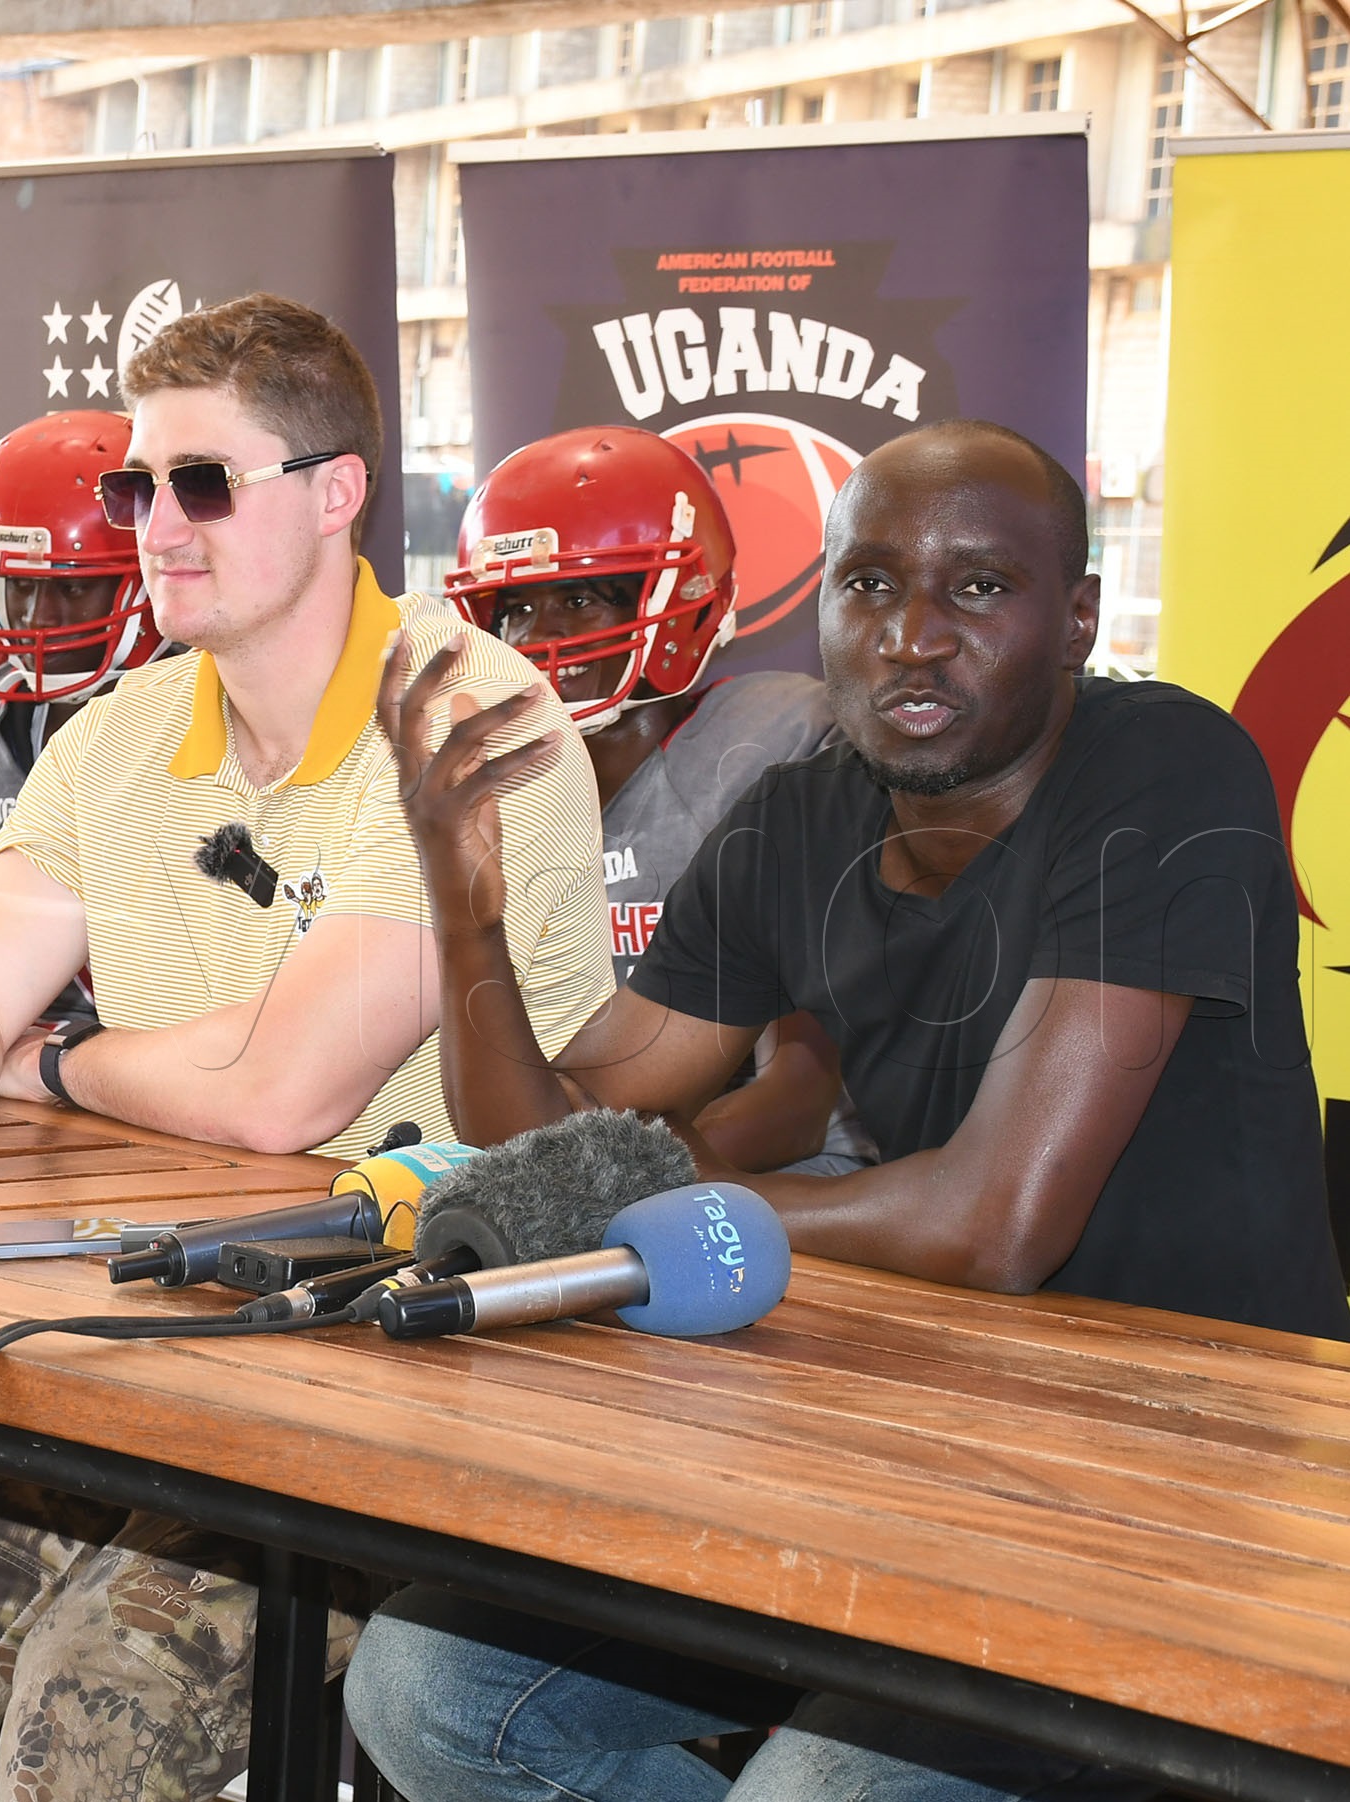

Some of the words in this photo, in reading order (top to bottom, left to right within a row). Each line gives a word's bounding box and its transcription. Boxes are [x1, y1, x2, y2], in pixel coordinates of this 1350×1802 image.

[656, 253, 749, 271] AMERICAN
[751, 250, 836, 268] FOOTBALL
[678, 275, 786, 293] FEDERATION
[788, 274, 813, 291] OF
[592, 306, 927, 422] UGANDA
[493, 536, 534, 552] schutt
